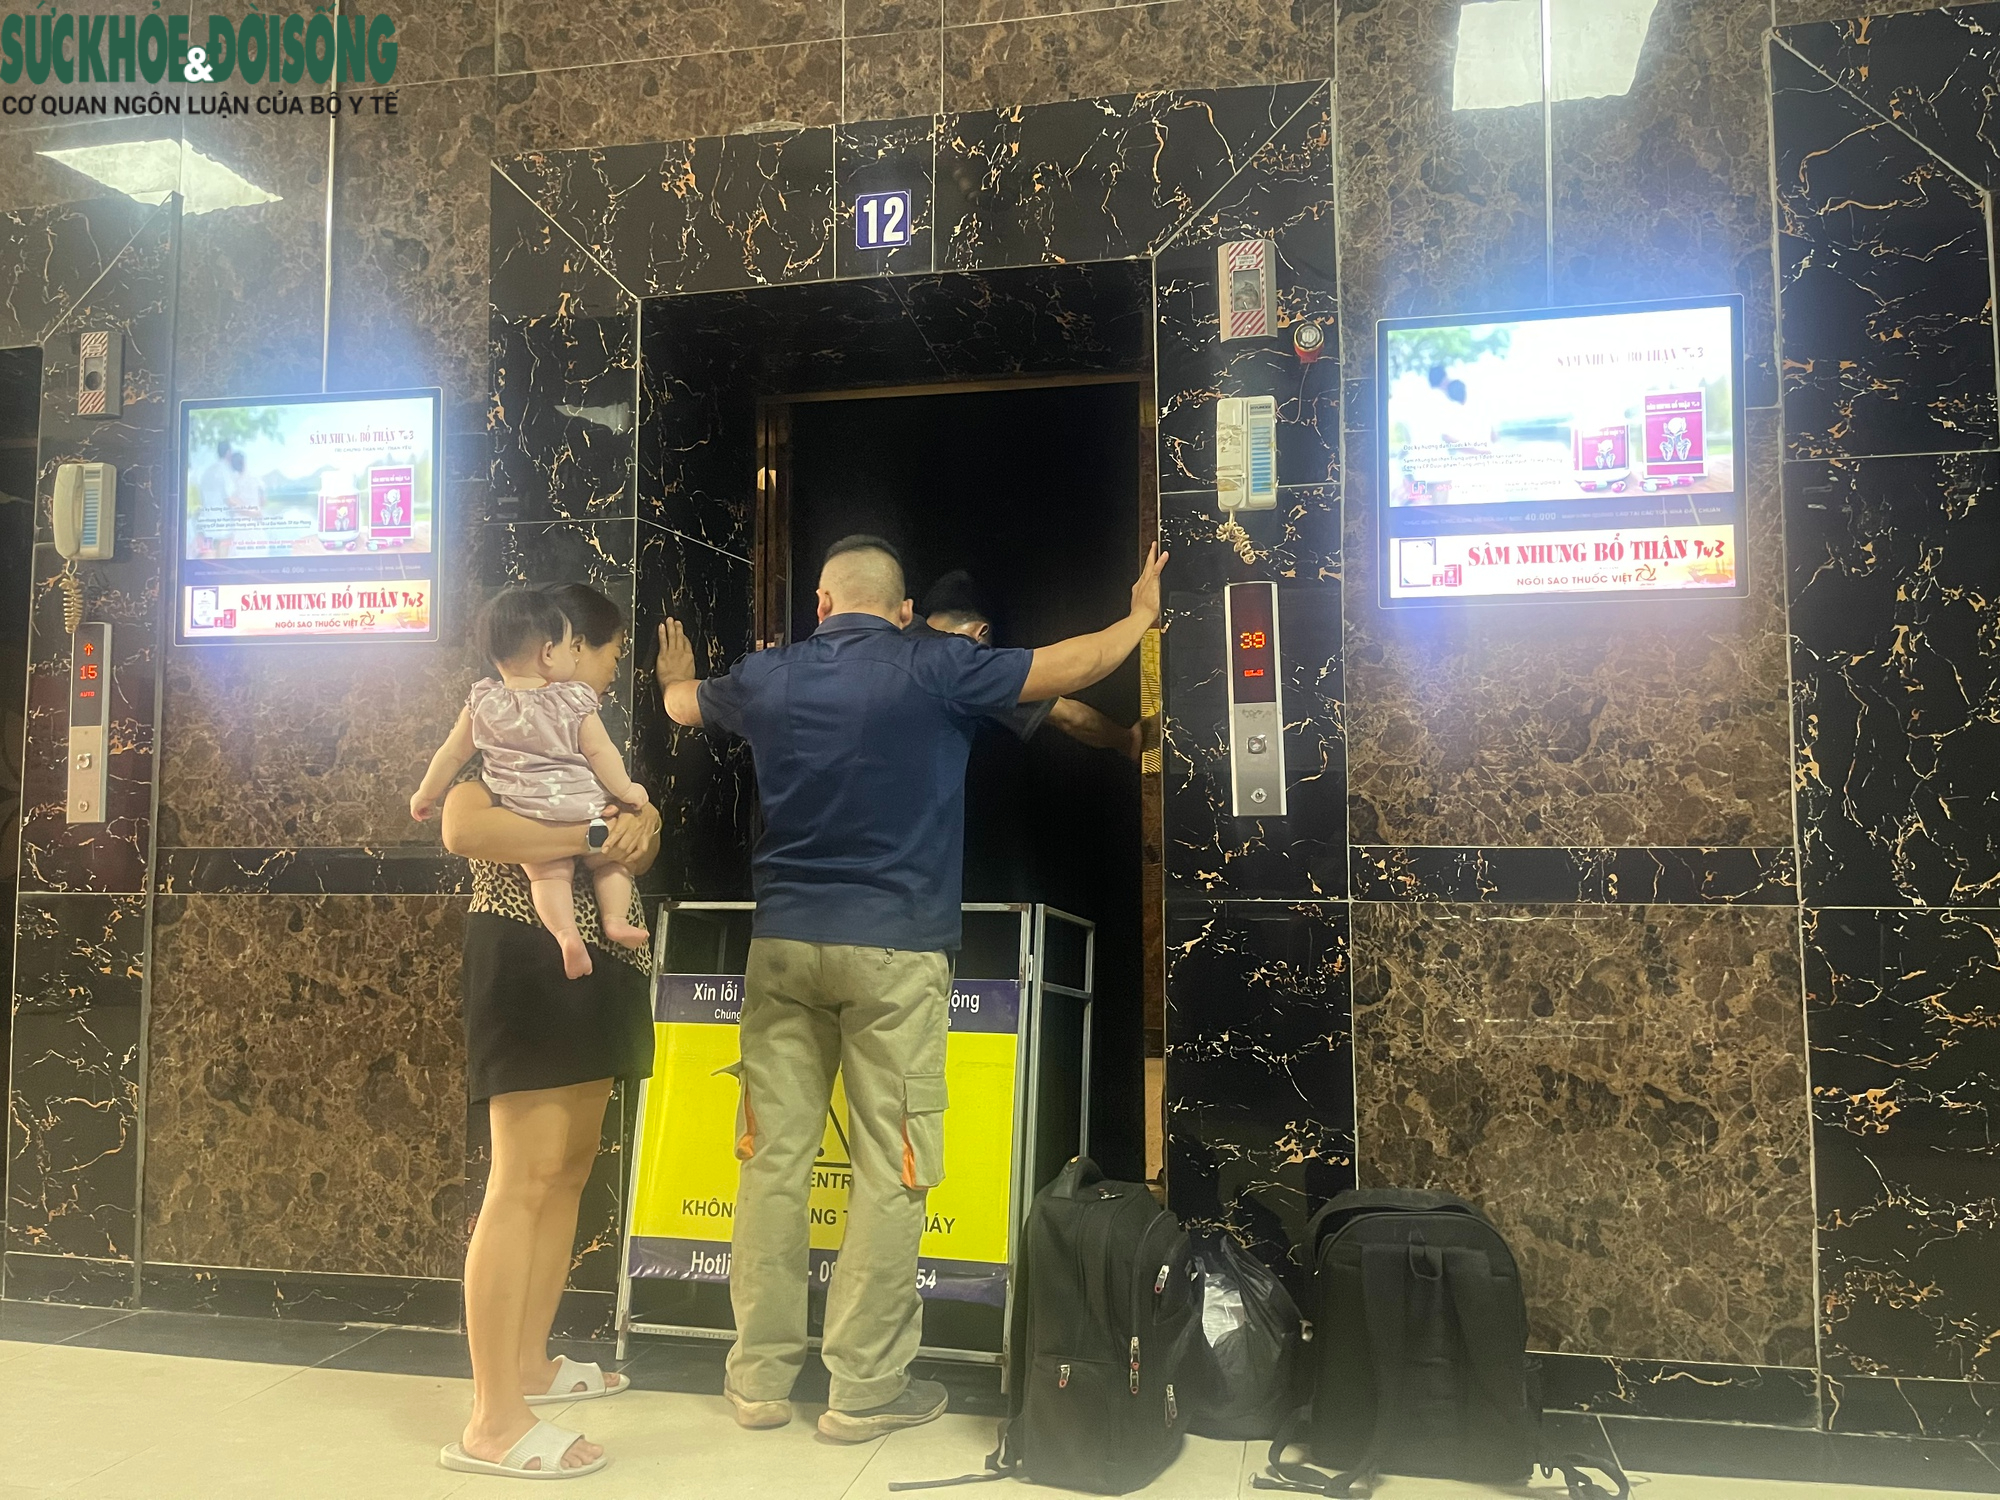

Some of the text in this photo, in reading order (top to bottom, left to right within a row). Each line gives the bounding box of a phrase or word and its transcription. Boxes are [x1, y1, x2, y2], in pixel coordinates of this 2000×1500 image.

[863, 196, 905, 244] 12
[1468, 541, 1510, 567] SÂM
[1516, 542, 1588, 564] NHUNG
[1594, 532, 1624, 561] BỔ
[1630, 534, 1688, 567] THẬN
[1547, 577, 1569, 585] SAO
[1572, 571, 1608, 584] THUỐC
[1611, 572, 1633, 585] VIỆT
[241, 590, 271, 611] SÂM
[275, 592, 327, 610] NHUNG
[331, 584, 353, 609] BỔ
[357, 587, 399, 614] THẬN
[275, 620, 295, 629] NGÔI
[297, 620, 313, 628] SAO
[315, 617, 341, 628] THUỐC
[343, 618, 358, 629] VIỆT
[1240, 632, 1266, 649] 39
[80, 664, 98, 680] 15
[693, 983, 716, 1001] Xin
[721, 980, 738, 1001] lỗi
[714, 1008, 741, 1023] Chúng
[682, 1197, 737, 1218] KHÔN
